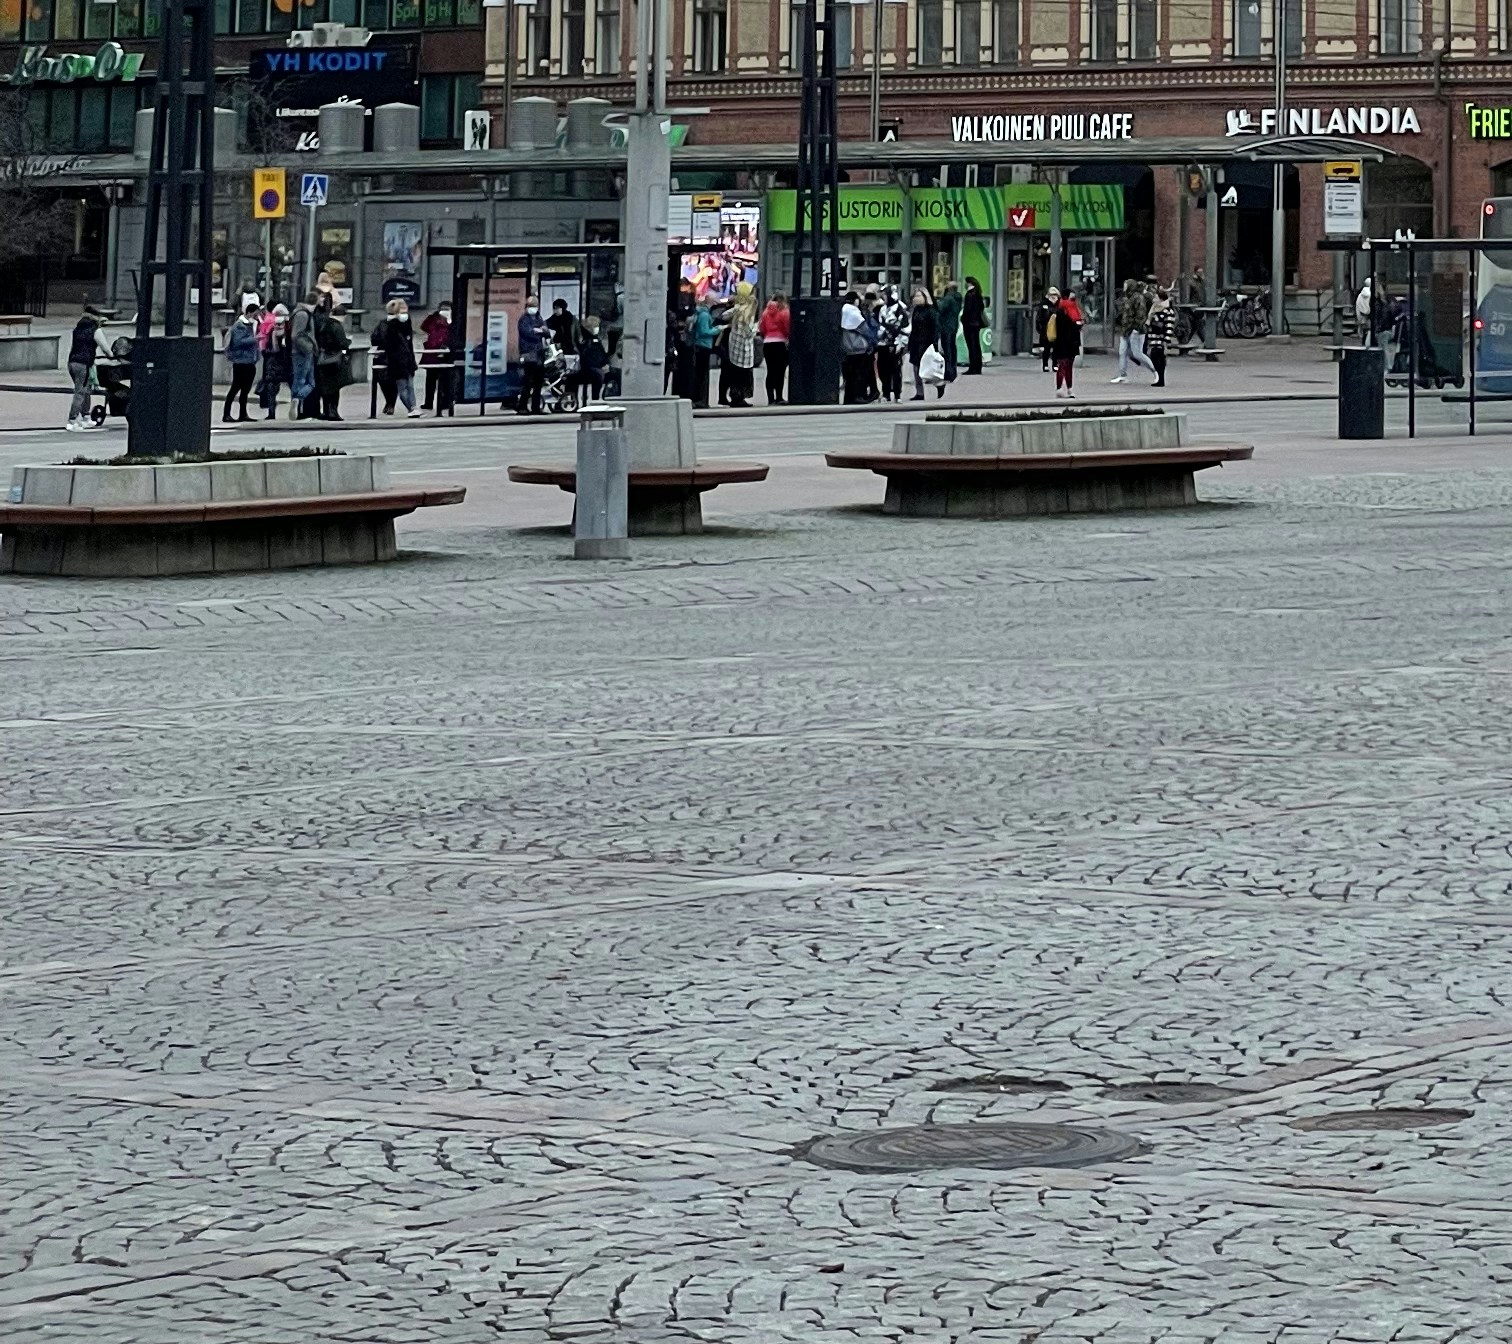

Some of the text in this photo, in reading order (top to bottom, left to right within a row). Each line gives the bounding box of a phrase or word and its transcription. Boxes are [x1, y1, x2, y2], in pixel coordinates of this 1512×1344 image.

[266, 52, 387, 71] YH KODIT
[952, 113, 1132, 141] VALKOINEN PUU CAFE
[914, 199, 968, 219] KIOSKI
[1489, 323, 1506, 336] 50
